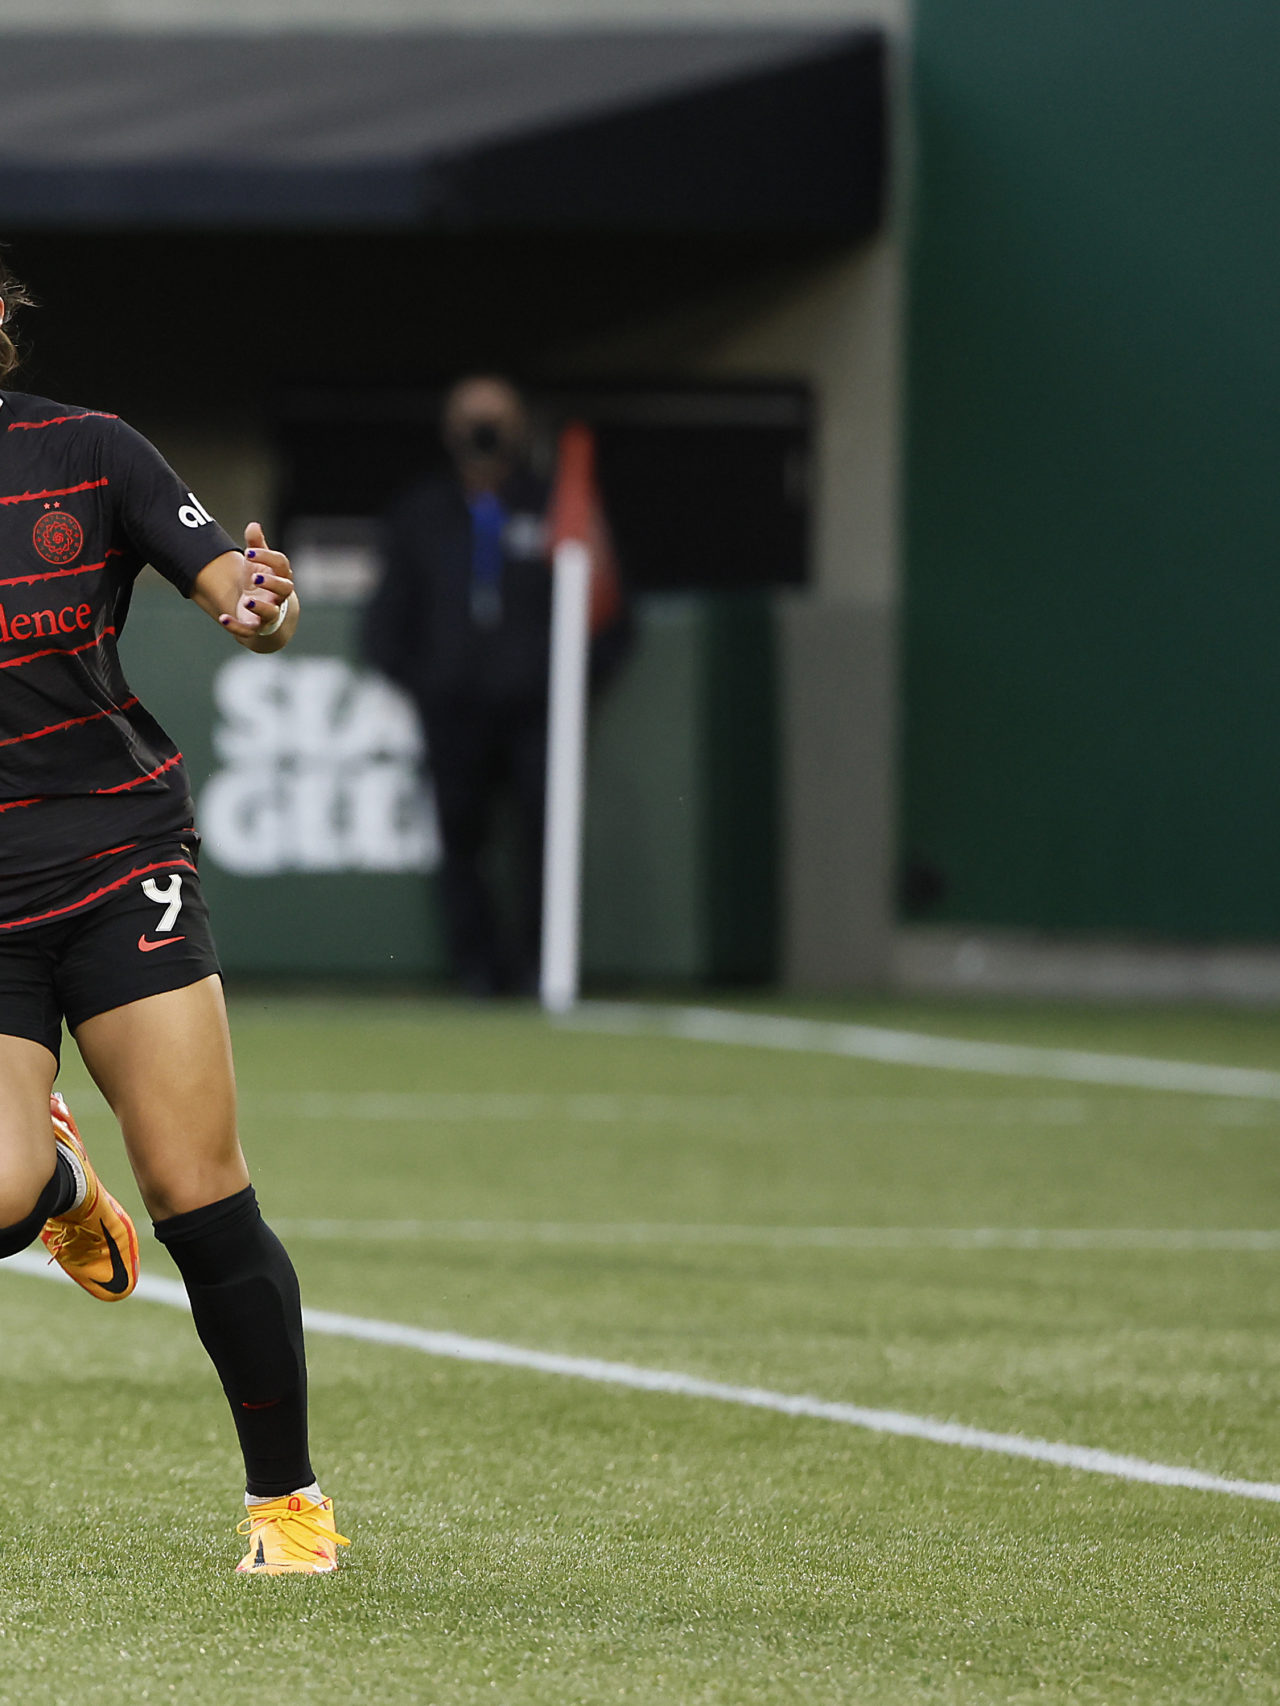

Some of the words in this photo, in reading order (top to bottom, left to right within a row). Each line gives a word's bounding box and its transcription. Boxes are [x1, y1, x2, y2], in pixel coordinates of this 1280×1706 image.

[212, 652, 424, 758] SEA
[200, 765, 442, 875] GEE
[141, 873, 183, 932] 9
